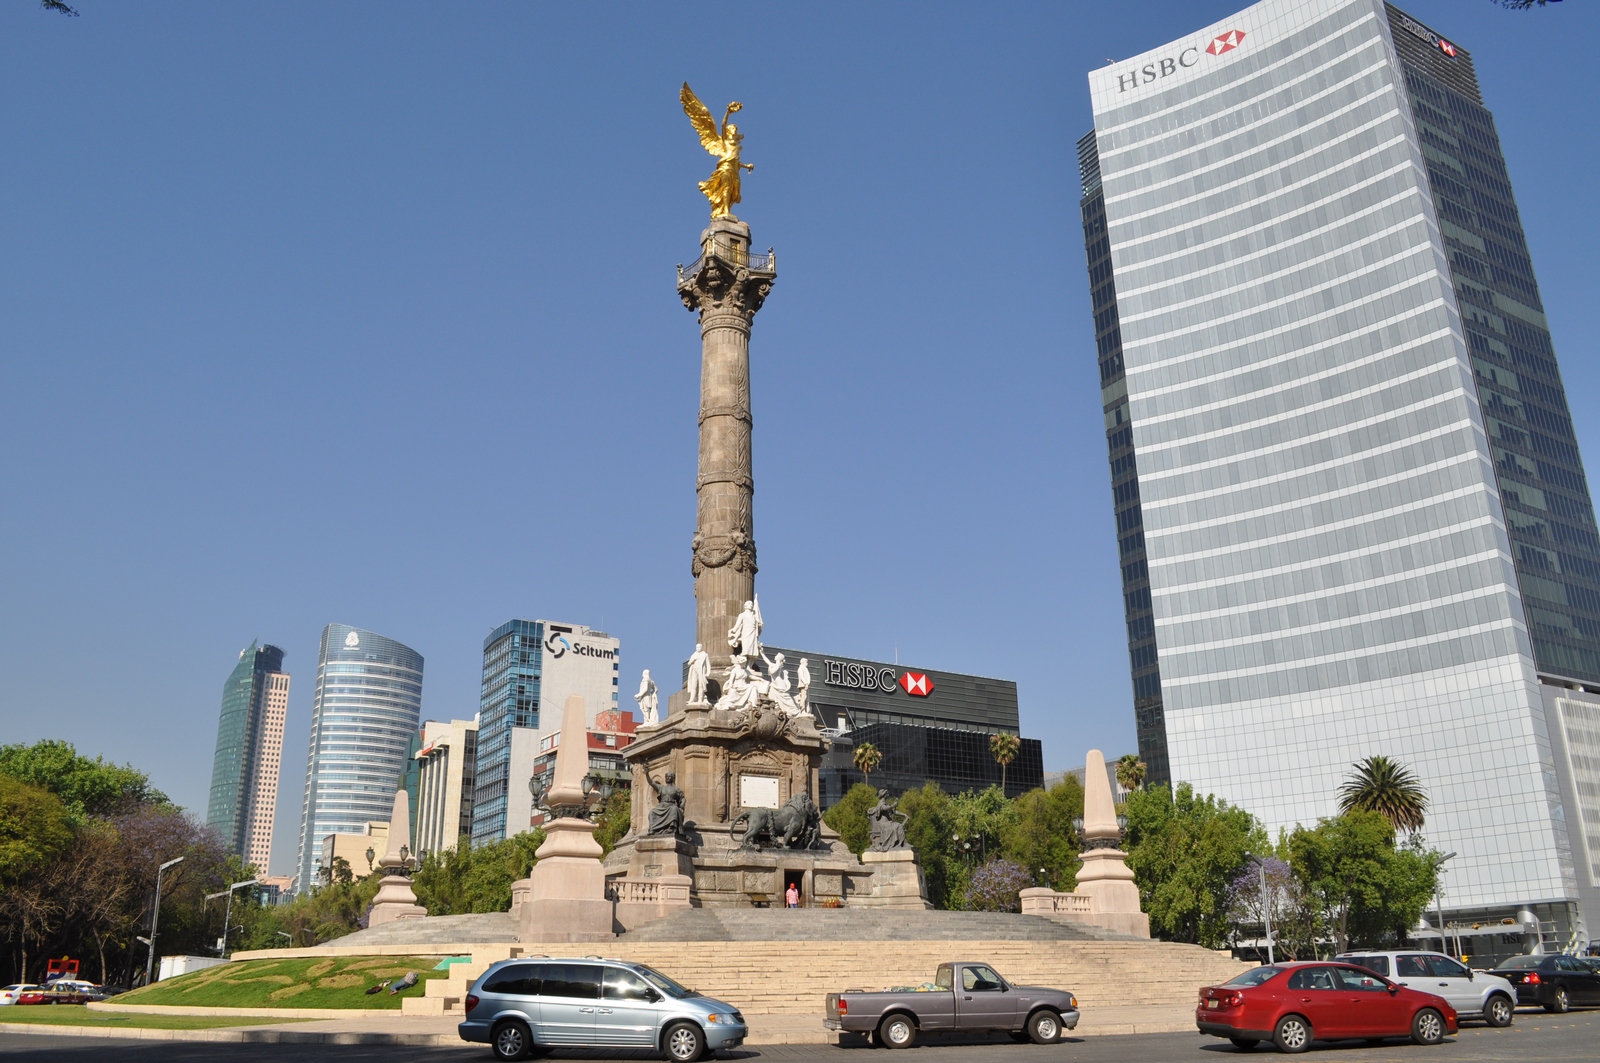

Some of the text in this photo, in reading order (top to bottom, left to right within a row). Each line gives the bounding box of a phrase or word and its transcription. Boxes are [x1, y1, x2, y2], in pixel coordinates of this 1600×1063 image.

[1400, 14, 1439, 48] HSBC
[1117, 47, 1200, 93] HSBC
[572, 642, 614, 660] Scitum
[824, 660, 896, 692] HSBC
